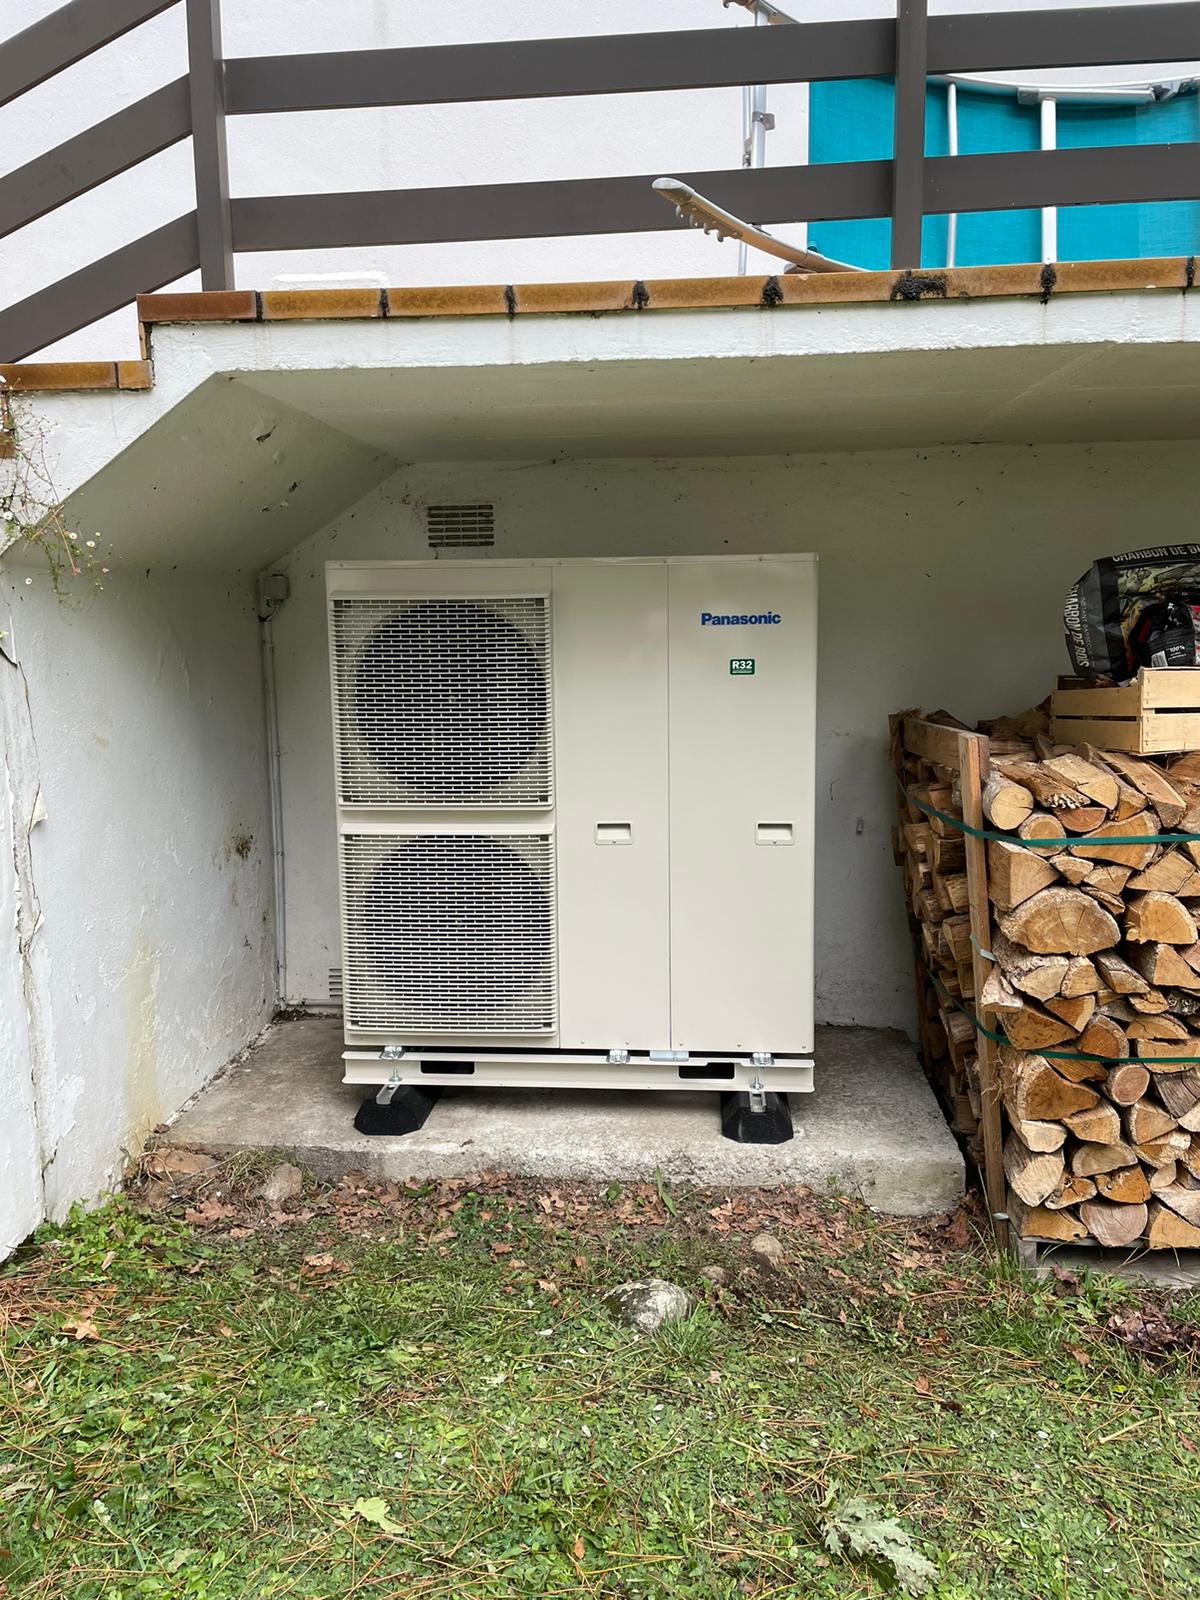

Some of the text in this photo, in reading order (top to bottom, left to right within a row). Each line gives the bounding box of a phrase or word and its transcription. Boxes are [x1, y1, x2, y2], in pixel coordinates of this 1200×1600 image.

[1170, 546, 1187, 555] DE
[701, 611, 781, 626] Panasonic
[1071, 631, 1084, 645] DE
[1169, 645, 1185, 653] 100%
[732, 661, 752, 669] R32
